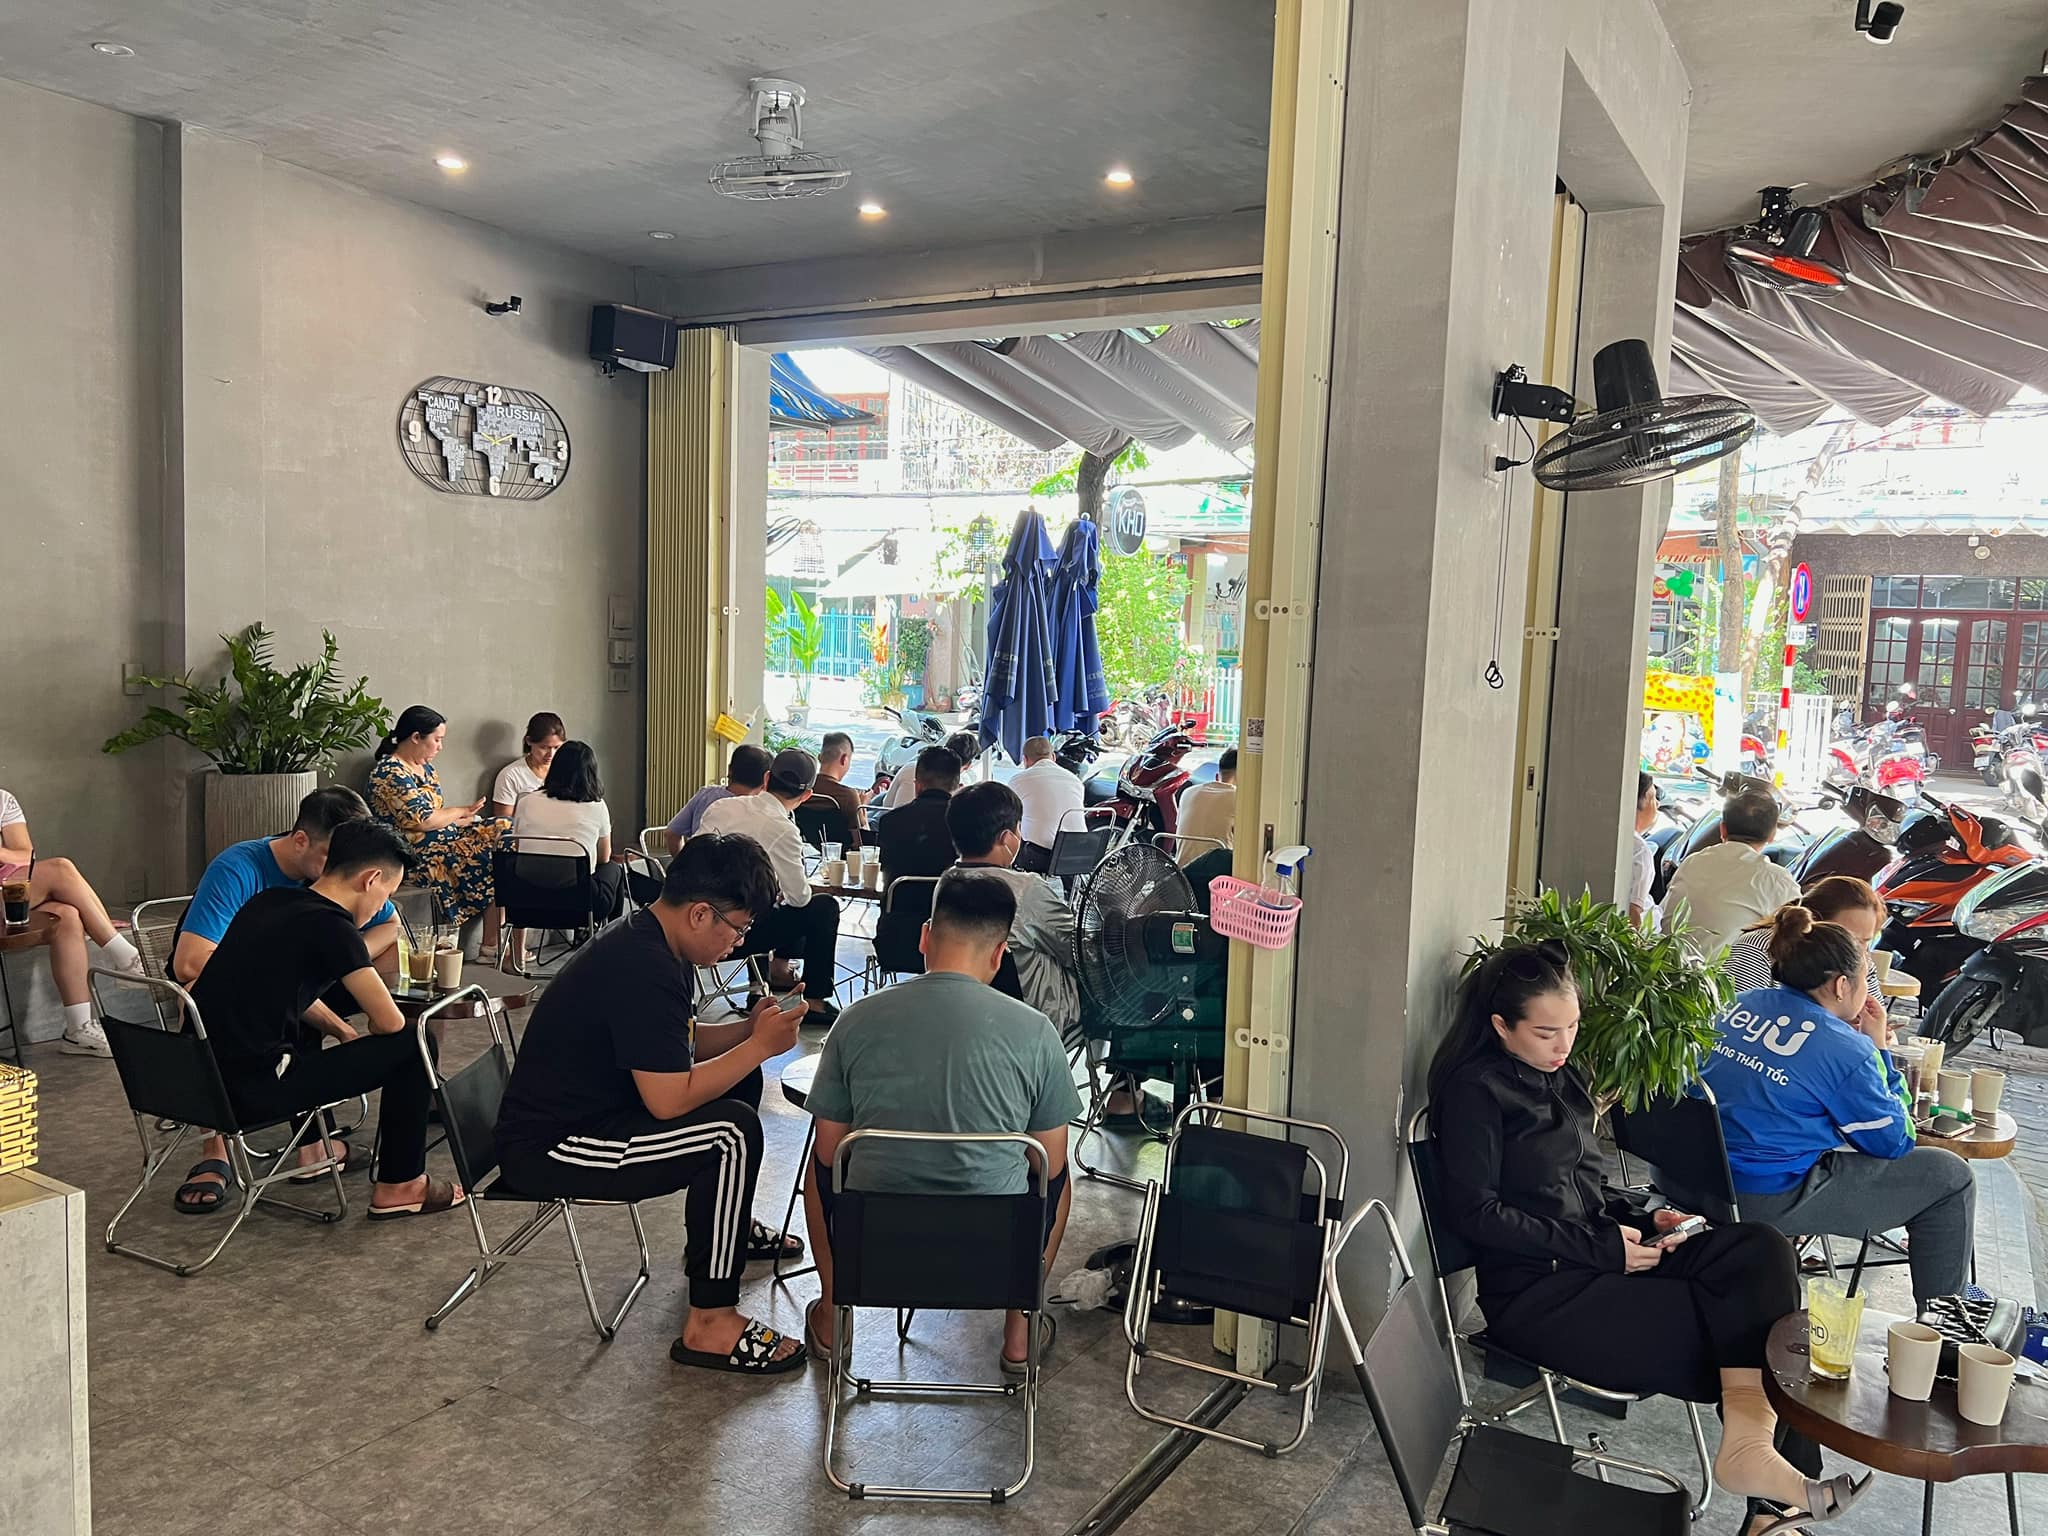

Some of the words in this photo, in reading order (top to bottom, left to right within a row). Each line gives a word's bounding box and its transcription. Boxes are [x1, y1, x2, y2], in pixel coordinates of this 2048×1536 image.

[428, 396, 460, 412] CANADA
[486, 386, 503, 405] 12
[496, 406, 541, 423] RUSSIA
[409, 421, 422, 443] 9
[556, 440, 569, 461] 3
